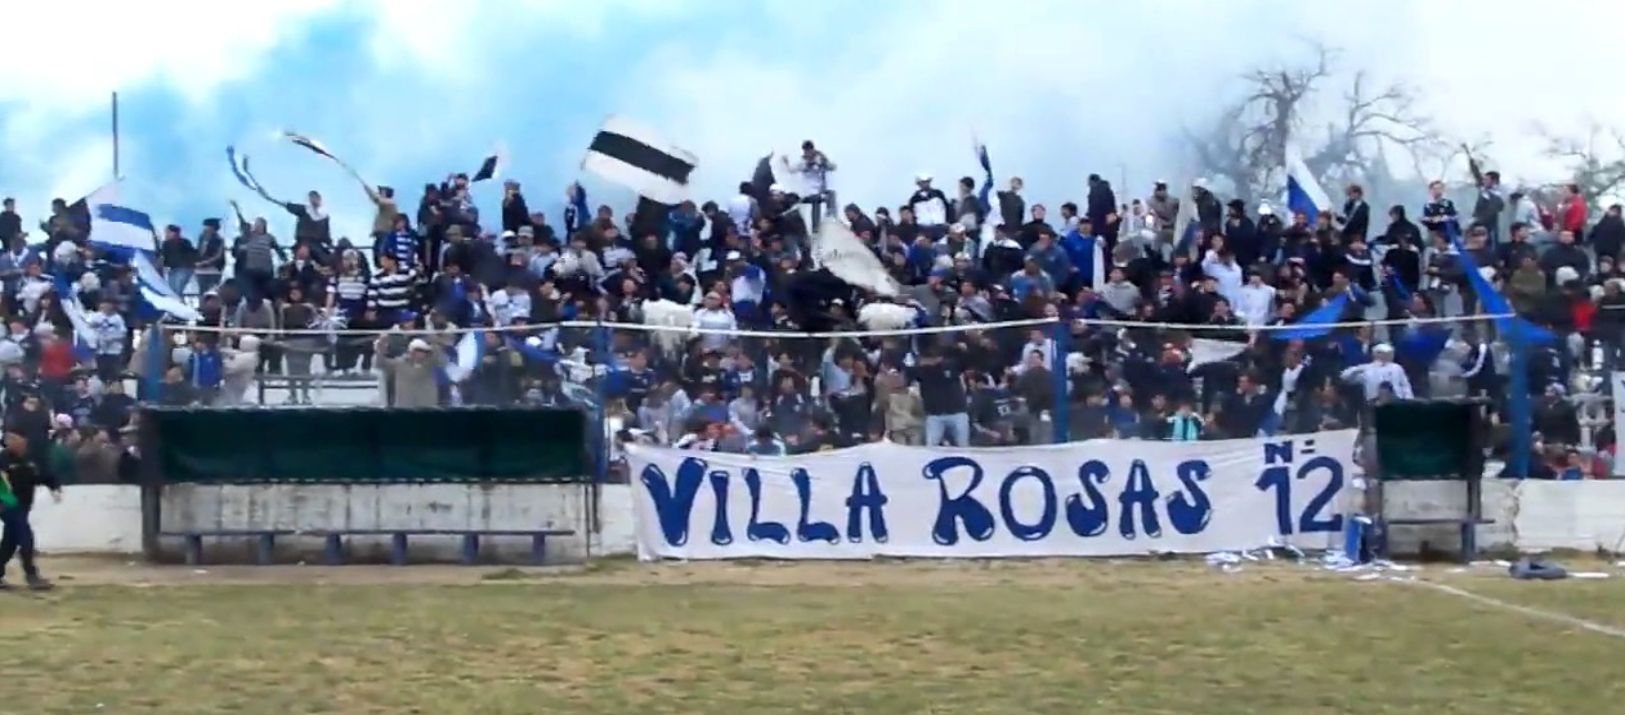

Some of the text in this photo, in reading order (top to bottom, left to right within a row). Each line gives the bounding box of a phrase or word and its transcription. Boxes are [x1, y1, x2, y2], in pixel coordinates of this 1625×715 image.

[640, 455, 1344, 547] VILLA ROSAS 12
